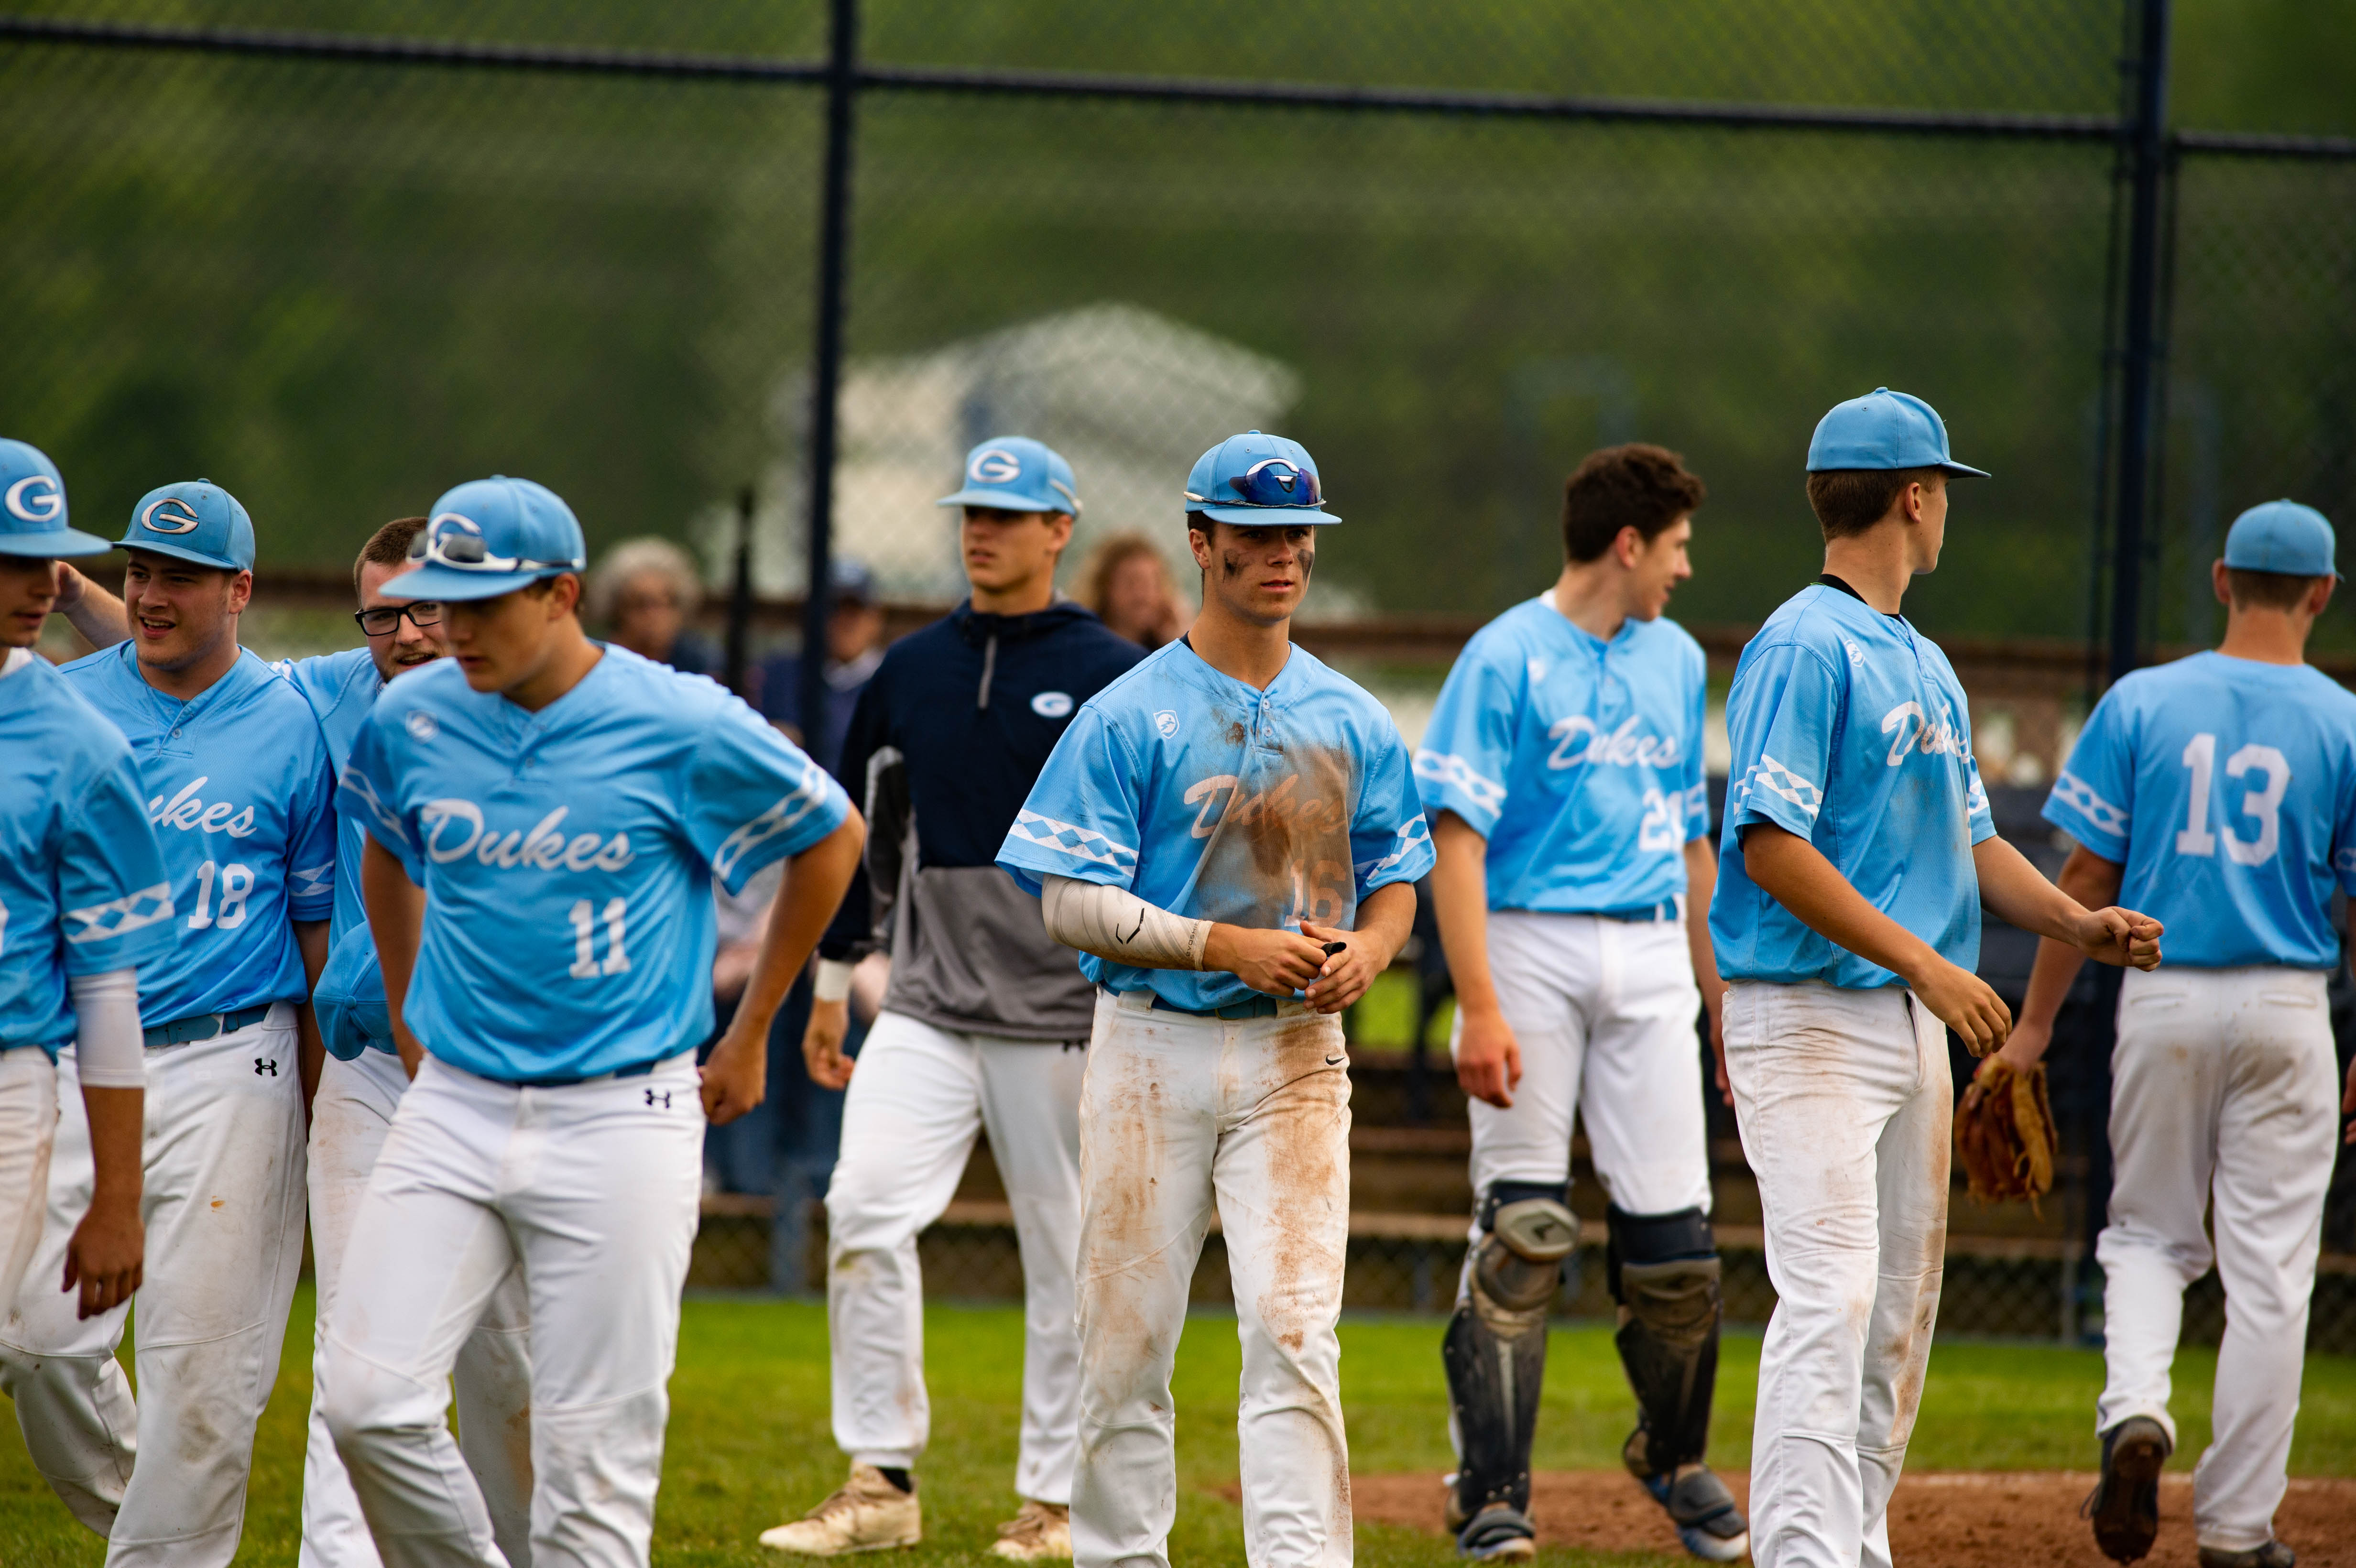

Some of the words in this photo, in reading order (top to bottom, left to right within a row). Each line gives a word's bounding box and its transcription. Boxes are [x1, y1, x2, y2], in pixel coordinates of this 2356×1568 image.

[5, 476, 62, 522] G
[970, 450, 1020, 483] G
[141, 498, 199, 534] G
[1546, 715, 1682, 770] Dukes
[1184, 773, 1347, 839] Dukes
[2175, 732, 2290, 867] 13
[421, 798, 636, 872] Dukes
[188, 860, 255, 929] 18
[1284, 859, 1347, 929] 16
[568, 897, 631, 979] 11
